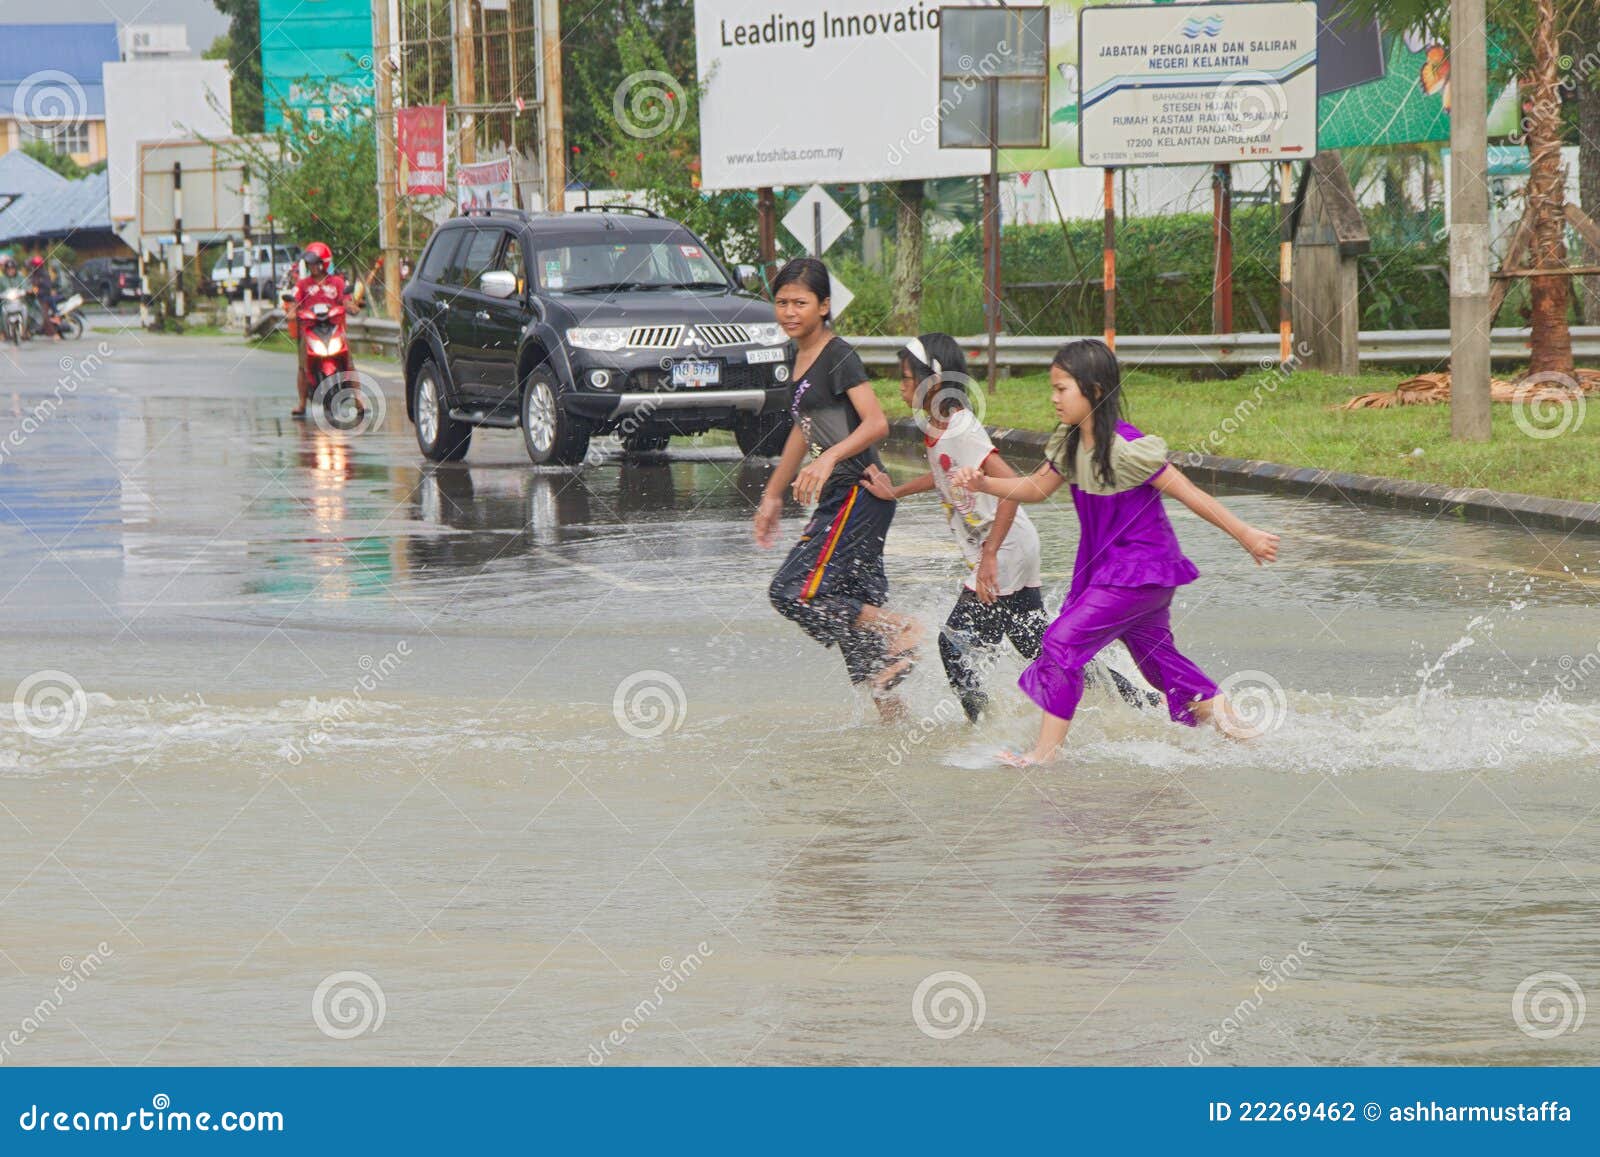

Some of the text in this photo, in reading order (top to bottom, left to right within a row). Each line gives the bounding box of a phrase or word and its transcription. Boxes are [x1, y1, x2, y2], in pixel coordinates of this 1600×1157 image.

[721, 13, 816, 49] Leading
[1099, 40, 1297, 57] JABATAN PENGAIRAN DAN SALIRAN
[1148, 55, 1249, 69] NEGERI KELANTAN
[1152, 91, 1198, 101] BAHAGIAN
[1162, 102, 1201, 112] STESEN
[1112, 115, 1148, 125] RUMAH
[1152, 114, 1194, 124] KASTAM
[1200, 113, 1239, 123] RANTAU
[1152, 124, 1242, 135] RANTAU PANJANG
[1126, 138, 1153, 148] 17200
[1157, 136, 1210, 147] KELANTAN
[726, 146, 844, 165] www.toshiba.com.my
[1239, 146, 1245, 155] 1
